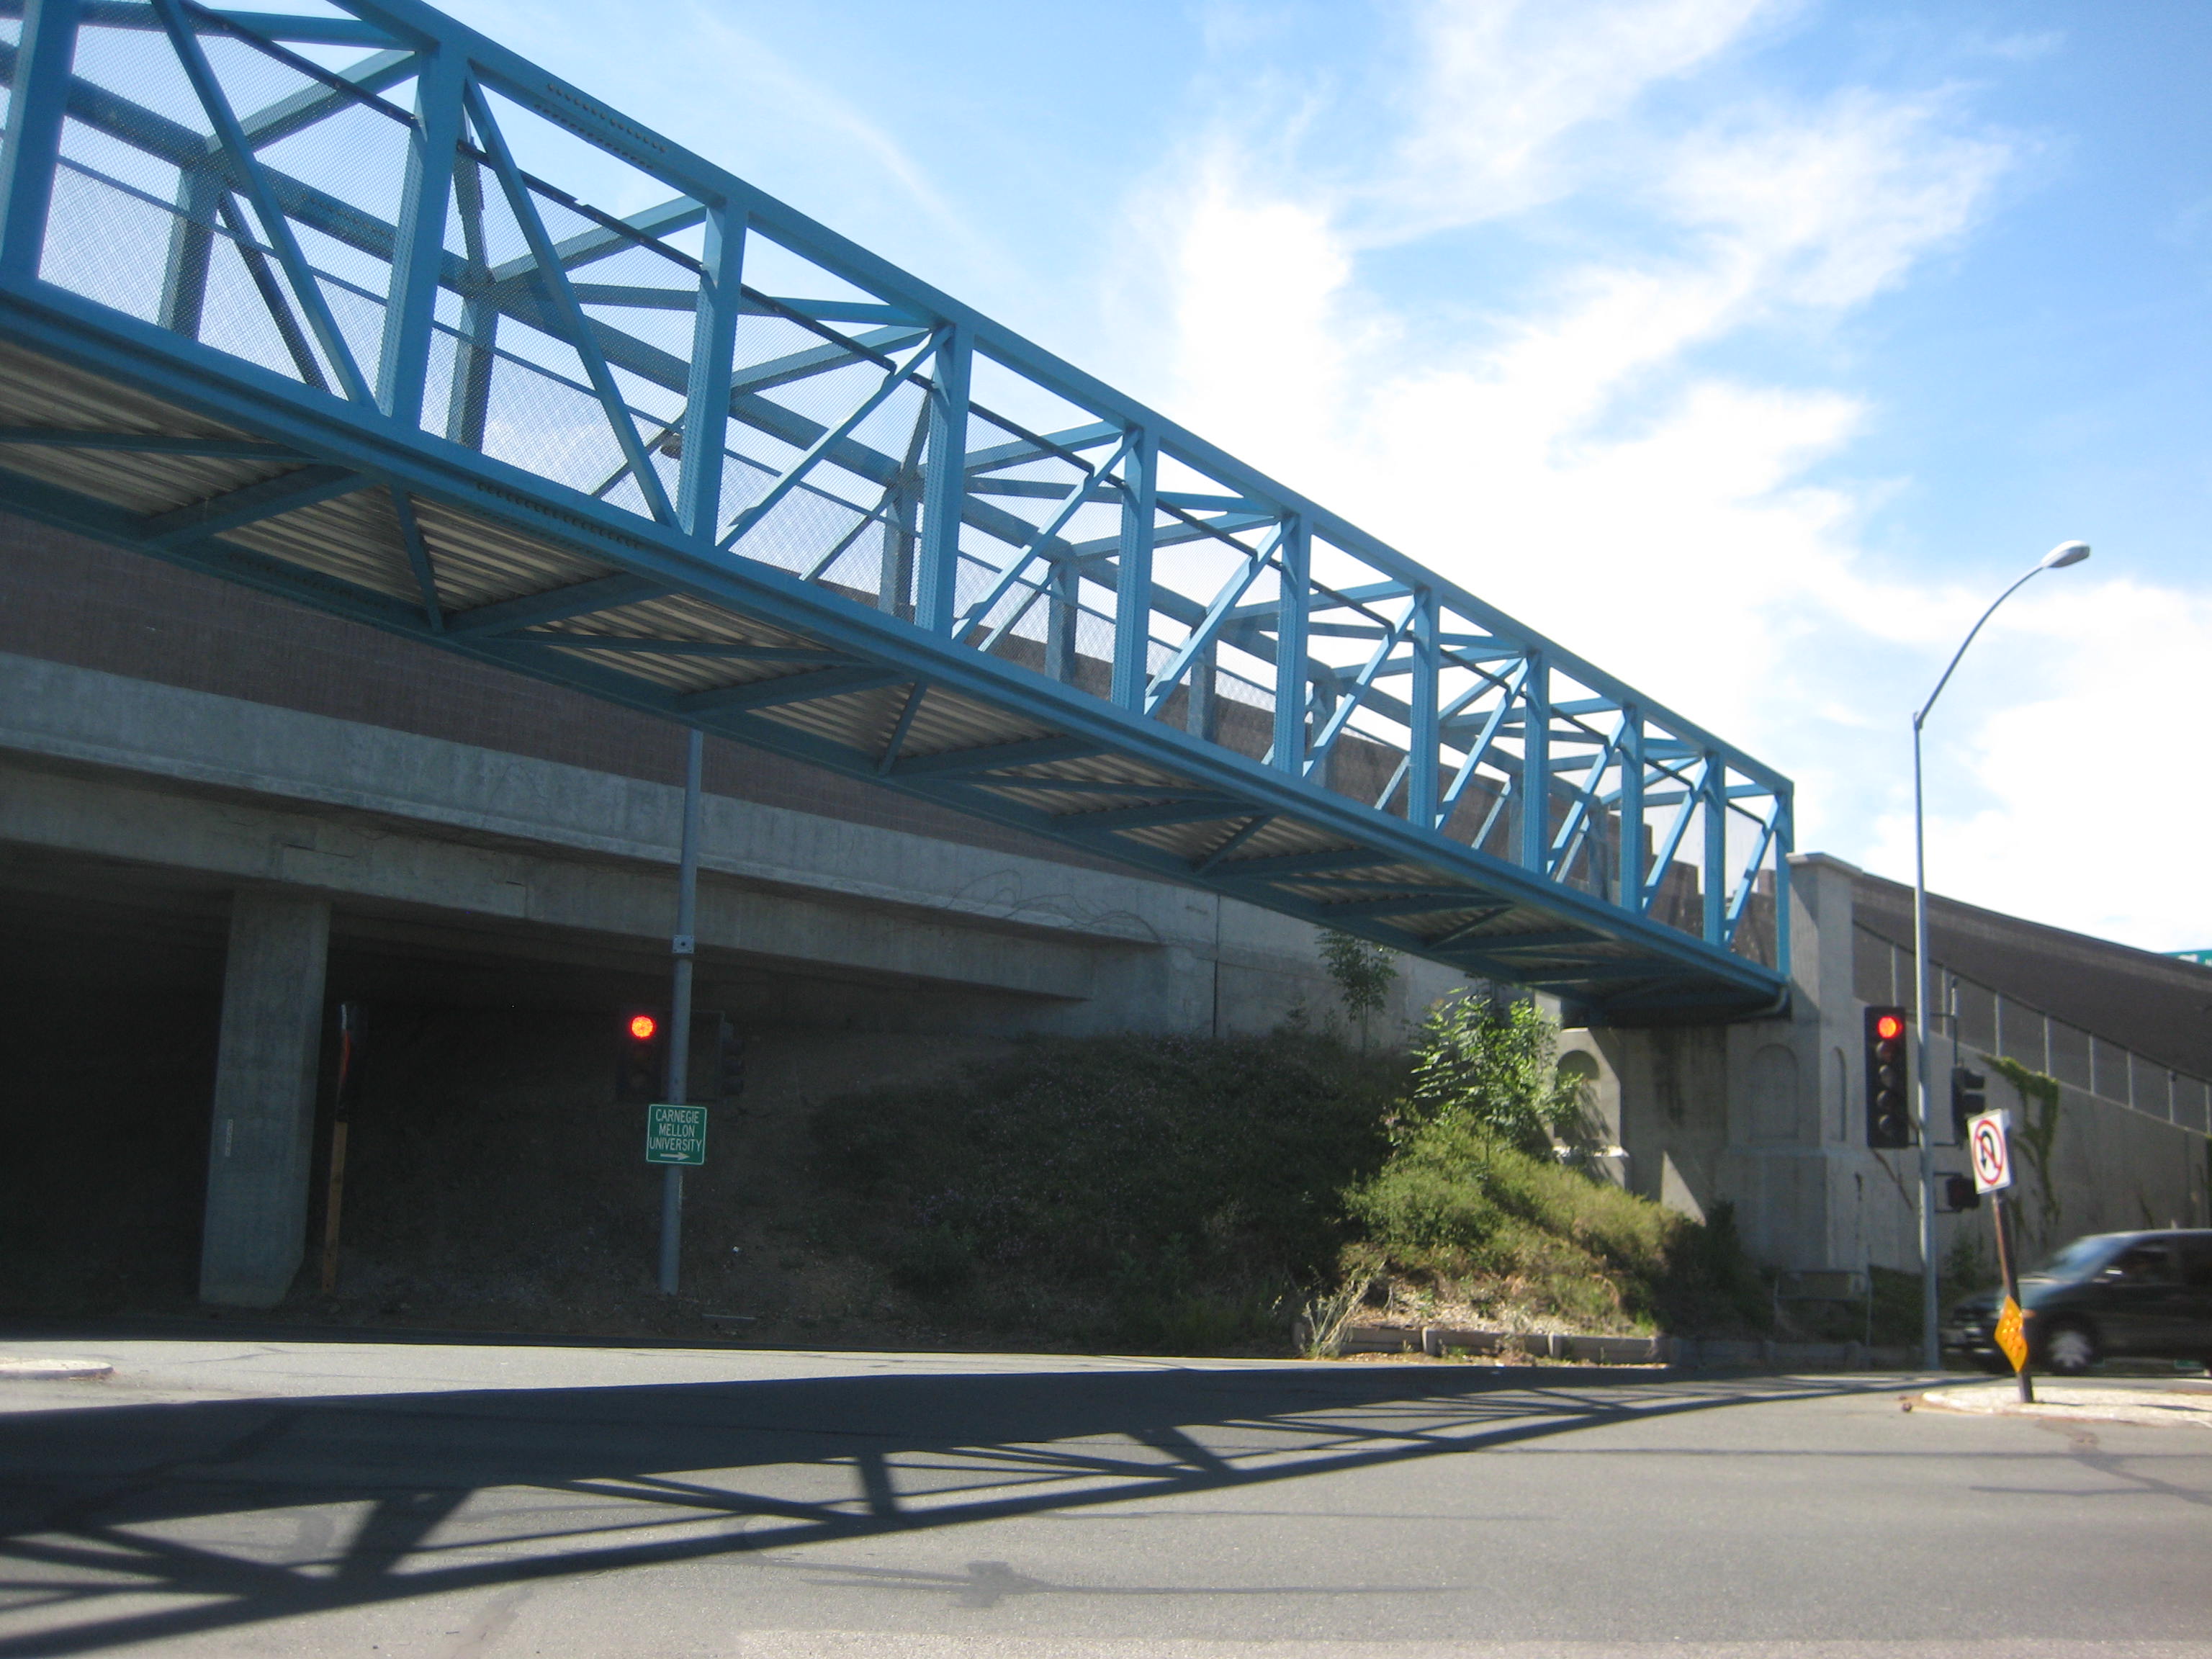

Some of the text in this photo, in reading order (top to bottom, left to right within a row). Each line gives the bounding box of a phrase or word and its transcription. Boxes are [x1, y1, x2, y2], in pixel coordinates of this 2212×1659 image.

[656, 1109, 700, 1123] CARNEGIE
[659, 1123, 695, 1137] MELLON
[649, 1137, 702, 1152] UNIVERSITY
